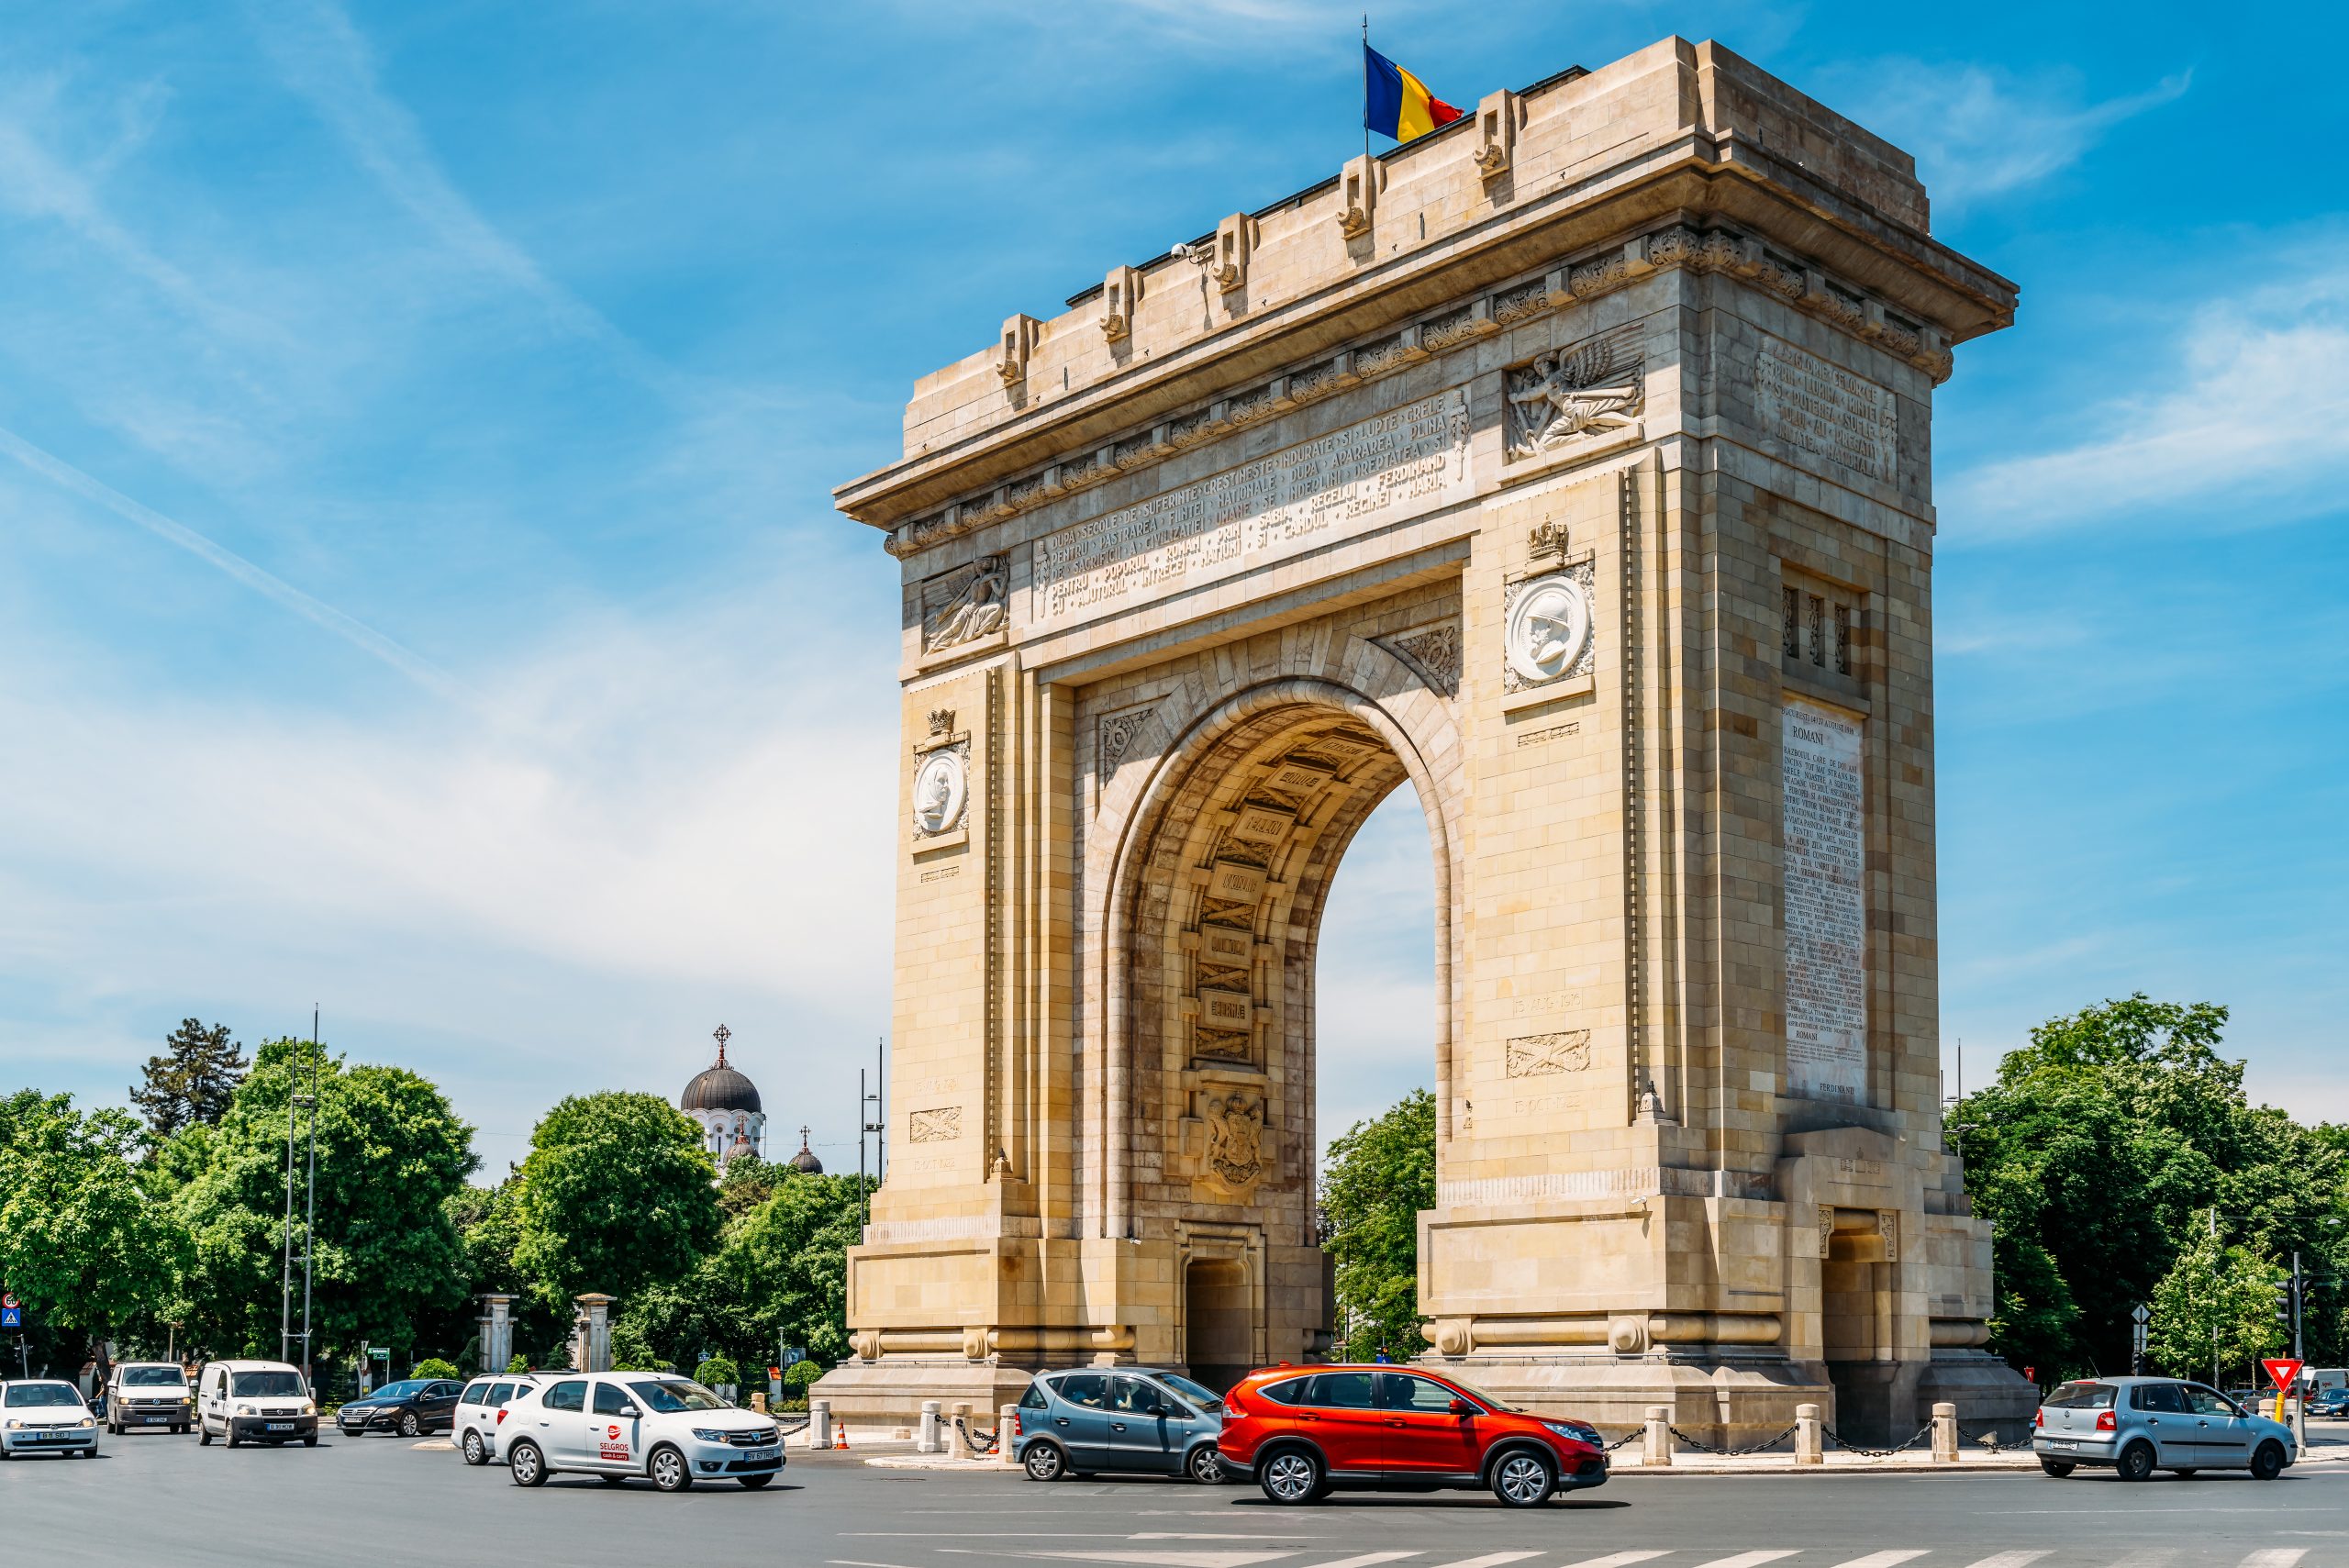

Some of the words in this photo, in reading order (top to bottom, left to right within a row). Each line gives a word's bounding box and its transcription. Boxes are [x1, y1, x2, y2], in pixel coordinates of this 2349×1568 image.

[1794, 351, 1828, 382] GLORIE
[1847, 394, 1876, 424] MINTEI
[1052, 528, 1076, 550] DUPA
[1081, 514, 1118, 539] SECOLE
[1124, 507, 1136, 524] DE
[1143, 485, 1197, 517] SUFERINTE
[1204, 458, 1274, 496] CRESTINESTE
[1281, 435, 1334, 469] INDURATE
[1341, 428, 1353, 448] SI
[1361, 413, 1398, 440] LUPTE
[1408, 395, 1445, 424] GRELE
[1052, 540, 1088, 566] PENTRU
[1100, 516, 1158, 549] PASTRAREA
[1168, 499, 1204, 526] FIINTEI
[1219, 473, 1276, 508] NATIONALE
[1291, 459, 1319, 483] DUPA
[1331, 432, 1395, 469] APARAREA
[1410, 413, 1447, 441] PLINA
[1052, 564, 1063, 583] DE
[1073, 545, 1122, 575] SACRIFICII
[1130, 539, 1138, 556] A
[1145, 517, 1204, 550] CIVILIZATIEI
[1216, 500, 1252, 526] UMANE
[1262, 492, 1276, 510] SE
[1289, 469, 1341, 501] INDEPLINI
[1354, 440, 1421, 479] DREPTATEA
[1432, 431, 1447, 451] SI
[1052, 573, 1088, 600] PENTRU
[1104, 552, 1149, 583] POPORUL
[1165, 535, 1201, 562] ROMAN
[1217, 521, 1241, 545] PRIN
[1258, 504, 1292, 531] SABIA
[1310, 481, 1357, 514] REGELUI
[1377, 450, 1446, 492] FERDINAND
[1052, 597, 1064, 617] CU
[1078, 576, 1128, 608] AJUTORUL
[1201, 538, 1241, 568] NATIUNI
[1257, 529, 1268, 550] SI
[1284, 509, 1329, 540] GANDUL
[1345, 489, 1390, 520] REGINEI
[1409, 469, 1447, 499] MARIA
[1792, 725, 1823, 745] ROMANI
[1812, 753, 1826, 764] CARE
[1830, 759, 1835, 767] DE
[1783, 765, 1799, 777] ARELE
[1804, 771, 1826, 784] NOASTRE
[1791, 806, 1815, 819] NATIONAL
[1819, 813, 1824, 822] SE
[1826, 815, 1841, 827] POATE
[1793, 825, 1813, 839] PENTRU
[1796, 1030, 1818, 1041] ROMANI
[1820, 1083, 1854, 1095] FERDINAND
[599, 1442, 629, 1451] SELGROS
[748, 1452, 755, 1461] BV
